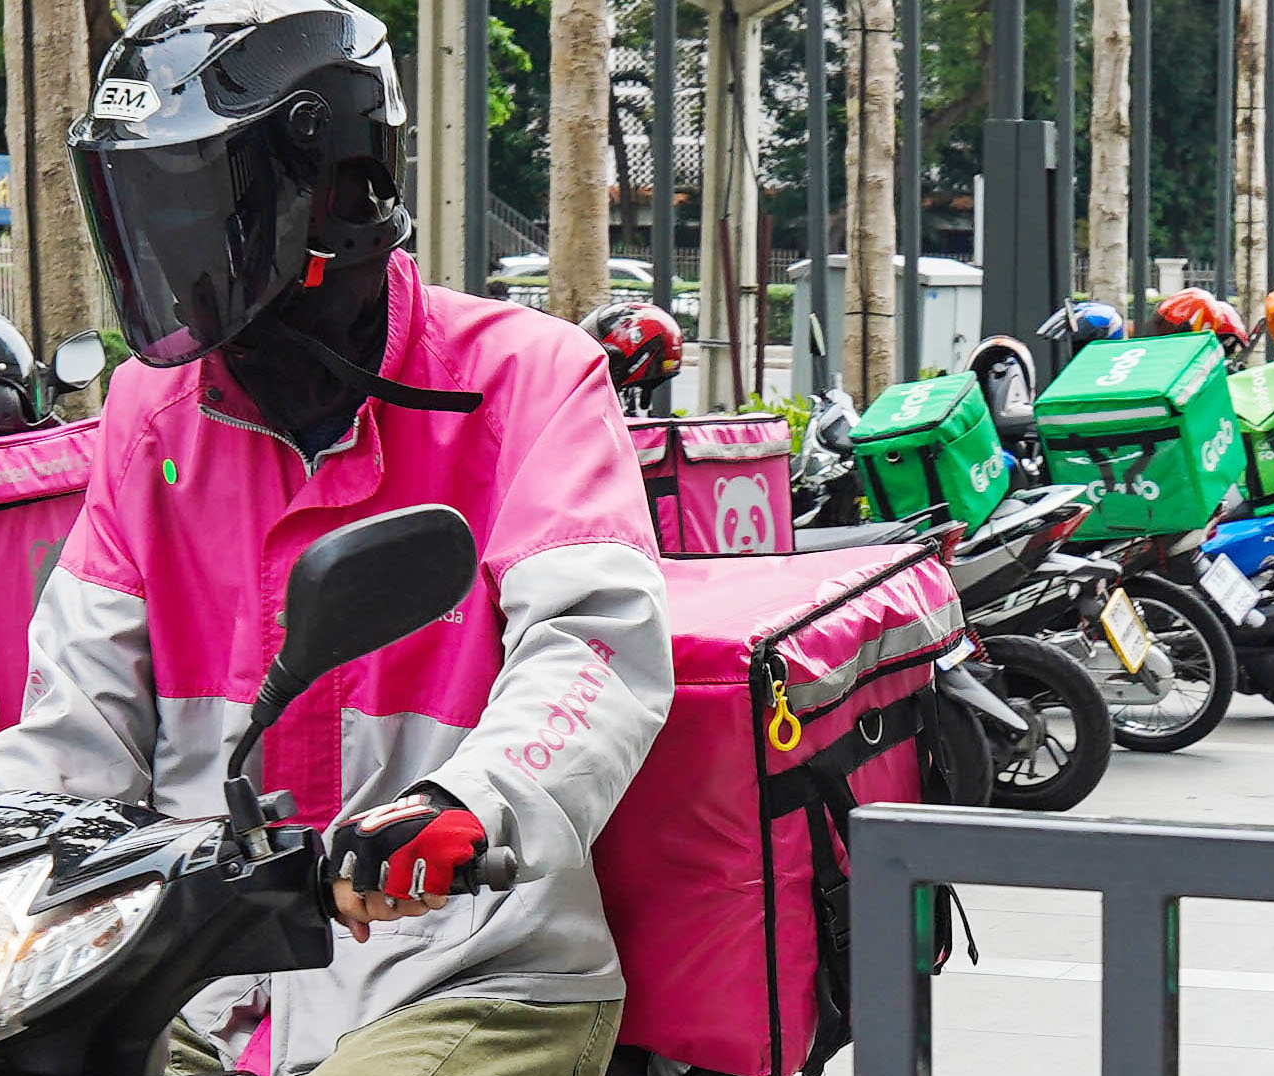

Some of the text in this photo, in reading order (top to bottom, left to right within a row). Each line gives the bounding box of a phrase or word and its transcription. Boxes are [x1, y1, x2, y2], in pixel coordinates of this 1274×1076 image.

[1096, 348, 1147, 387] Grab
[1201, 417, 1233, 472] Grab
[504, 638, 616, 781] foodpana
